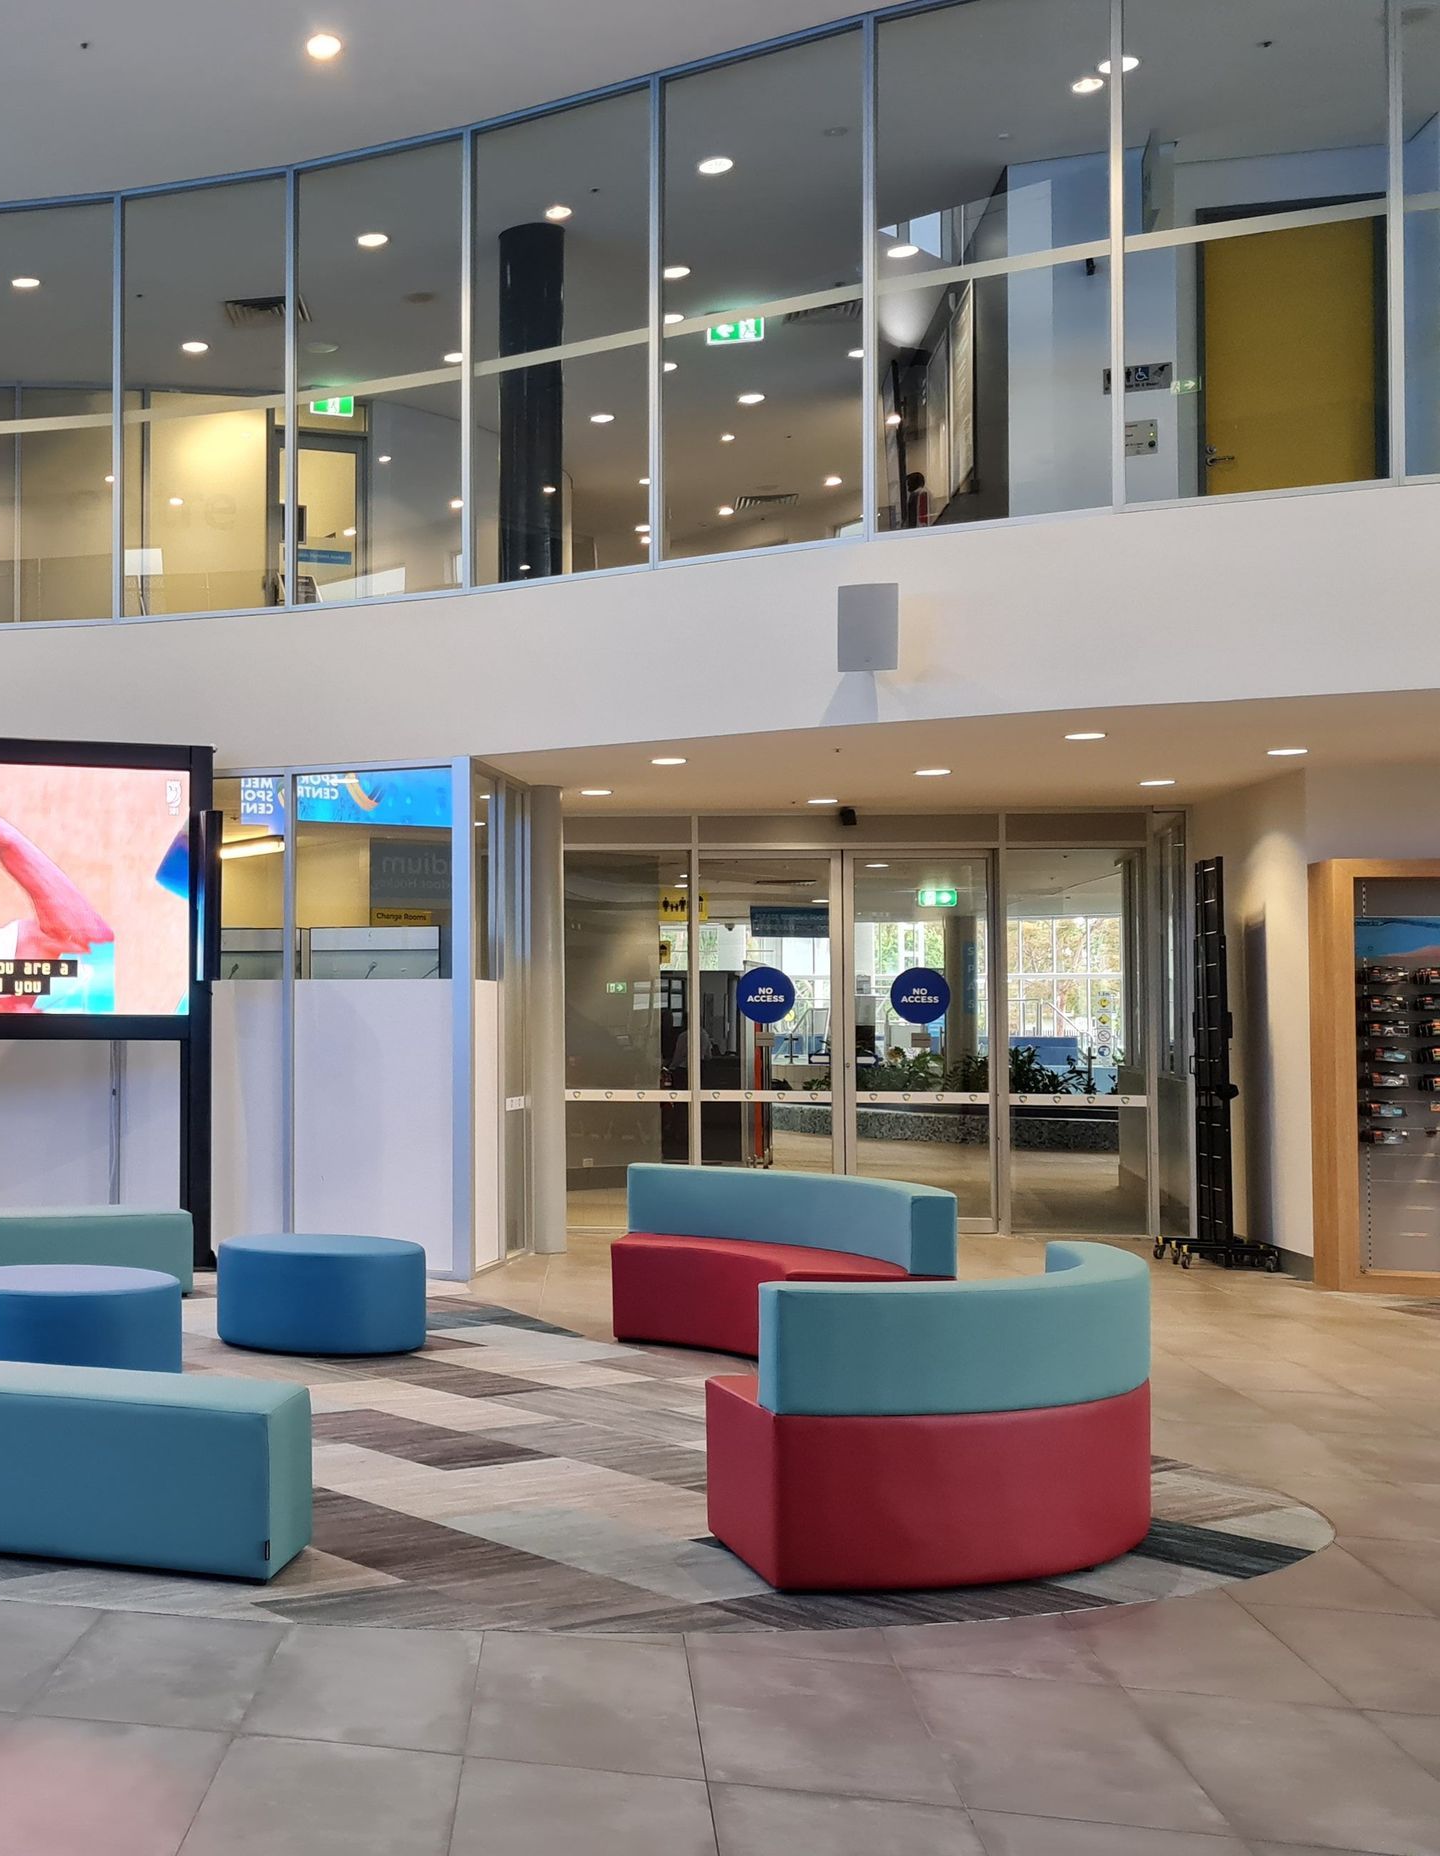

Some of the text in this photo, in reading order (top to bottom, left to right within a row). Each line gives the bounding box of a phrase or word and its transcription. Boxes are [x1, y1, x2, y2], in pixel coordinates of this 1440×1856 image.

[23, 962, 51, 975] are
[59, 963, 69, 976] a
[14, 981, 42, 997] you
[758, 987, 773, 995] NO
[747, 995, 785, 1003] ACCESS
